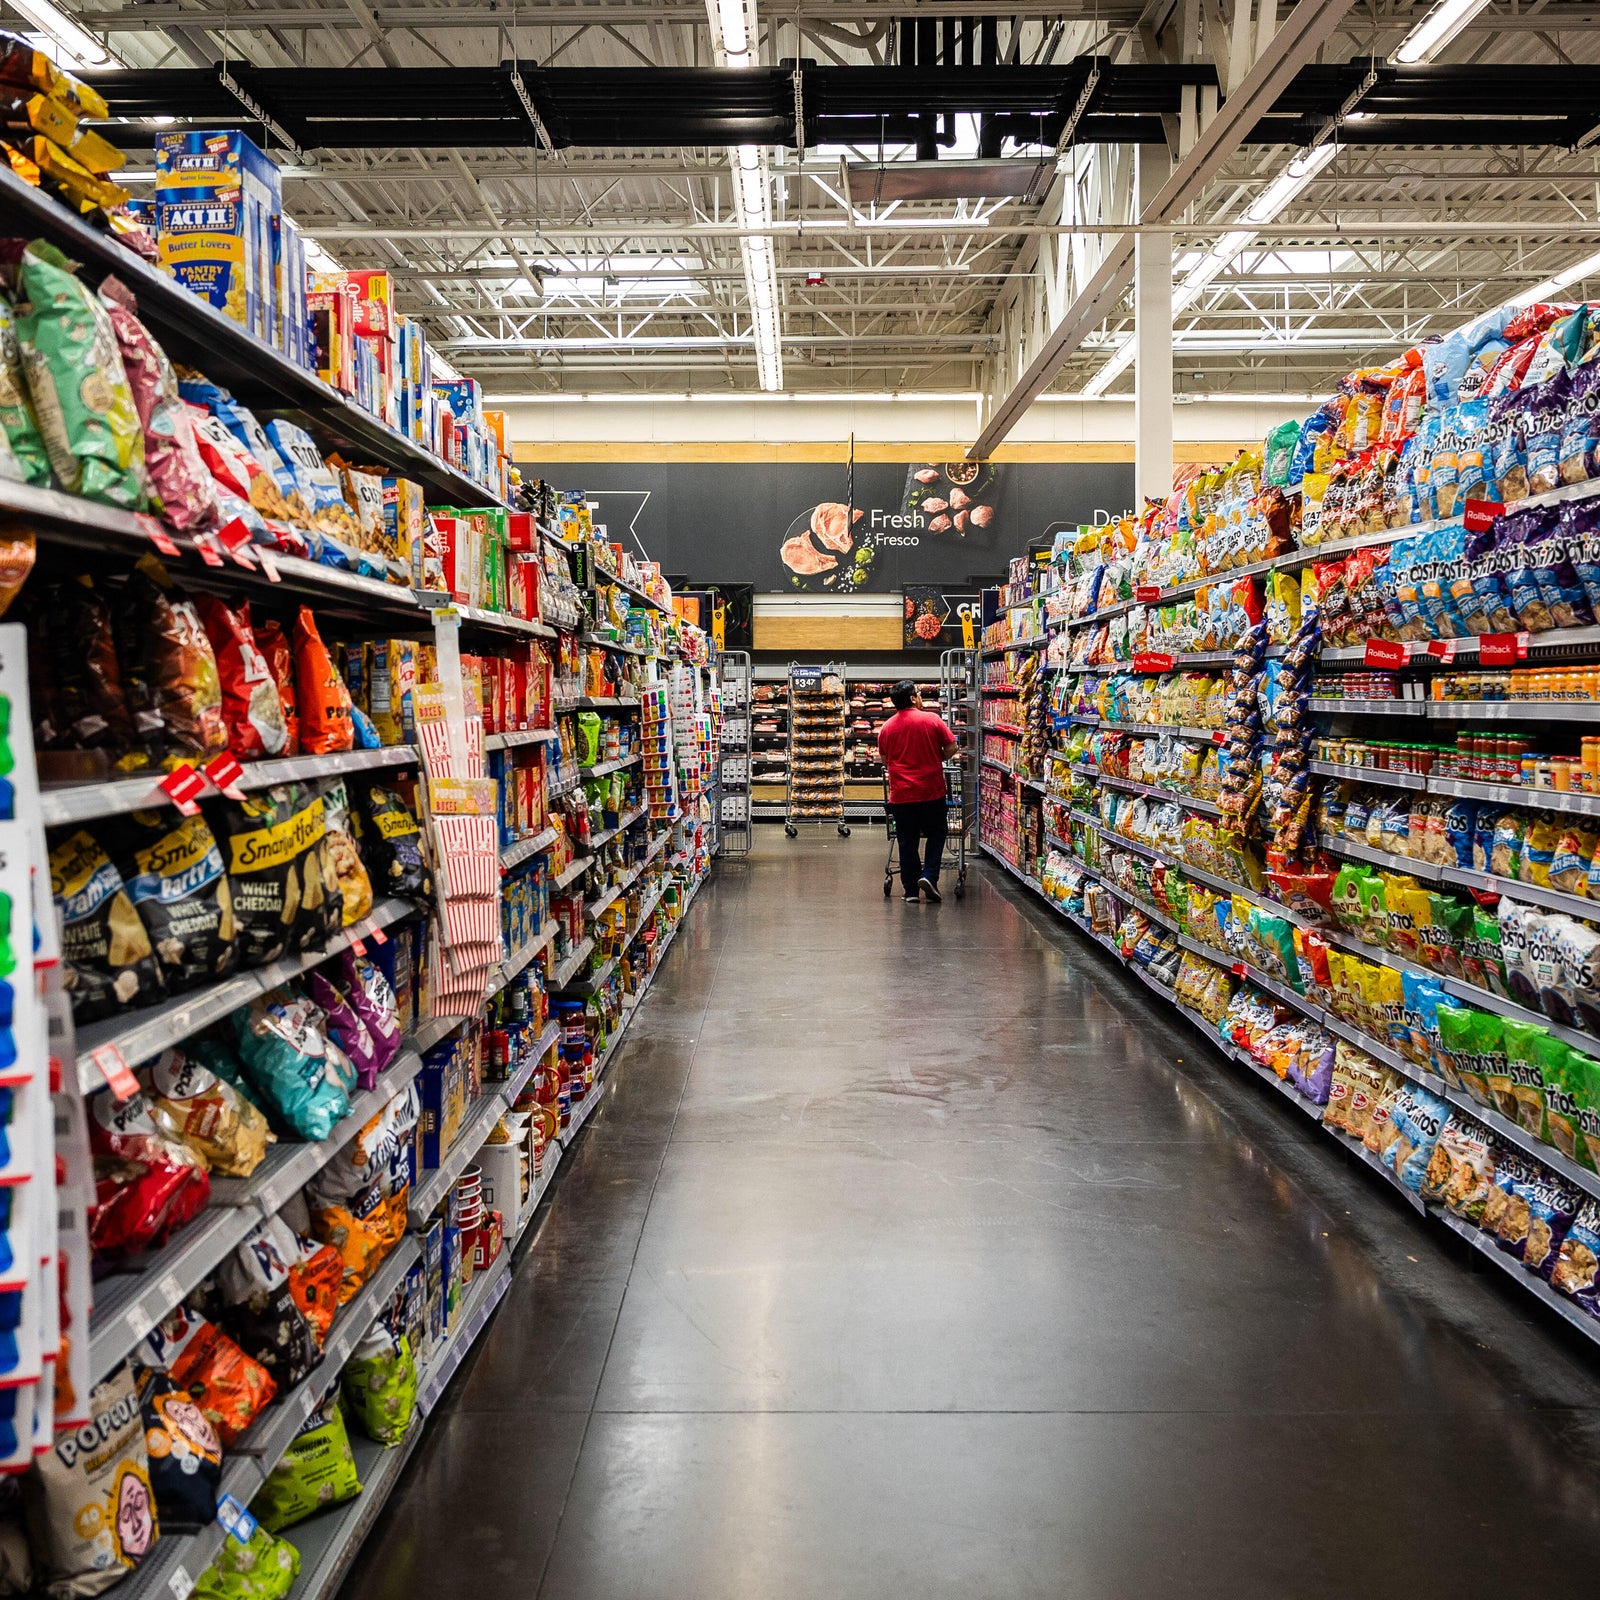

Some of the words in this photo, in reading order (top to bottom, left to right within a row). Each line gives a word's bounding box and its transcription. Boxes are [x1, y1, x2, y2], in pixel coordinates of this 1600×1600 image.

[181, 158, 201, 168] ACT
[202, 157, 214, 167] II
[170, 209, 203, 226] ACT
[206, 208, 227, 224] II
[168, 241, 198, 252] Butter
[200, 239, 232, 250] Lovers
[180, 265, 224, 276] PANTRY
[188, 273, 215, 282] PACK
[346, 282, 365, 323] Orville
[870, 509, 925, 529] Fresh
[1466, 510, 1494, 523] Rollbac
[875, 532, 920, 546] Fresco
[715, 632, 722, 640] A
[1367, 648, 1398, 660] Rollback
[1481, 644, 1512, 654] Rollback
[419, 706, 442, 718] BOXES
[436, 801, 457, 811] BOXES
[447, 850, 469, 859] CORN
[161, 861, 207, 898] Party
[241, 881, 280, 896] WHITE
[166, 900, 207, 919] WHITE
[169, 914, 219, 936] CHEDDAR
